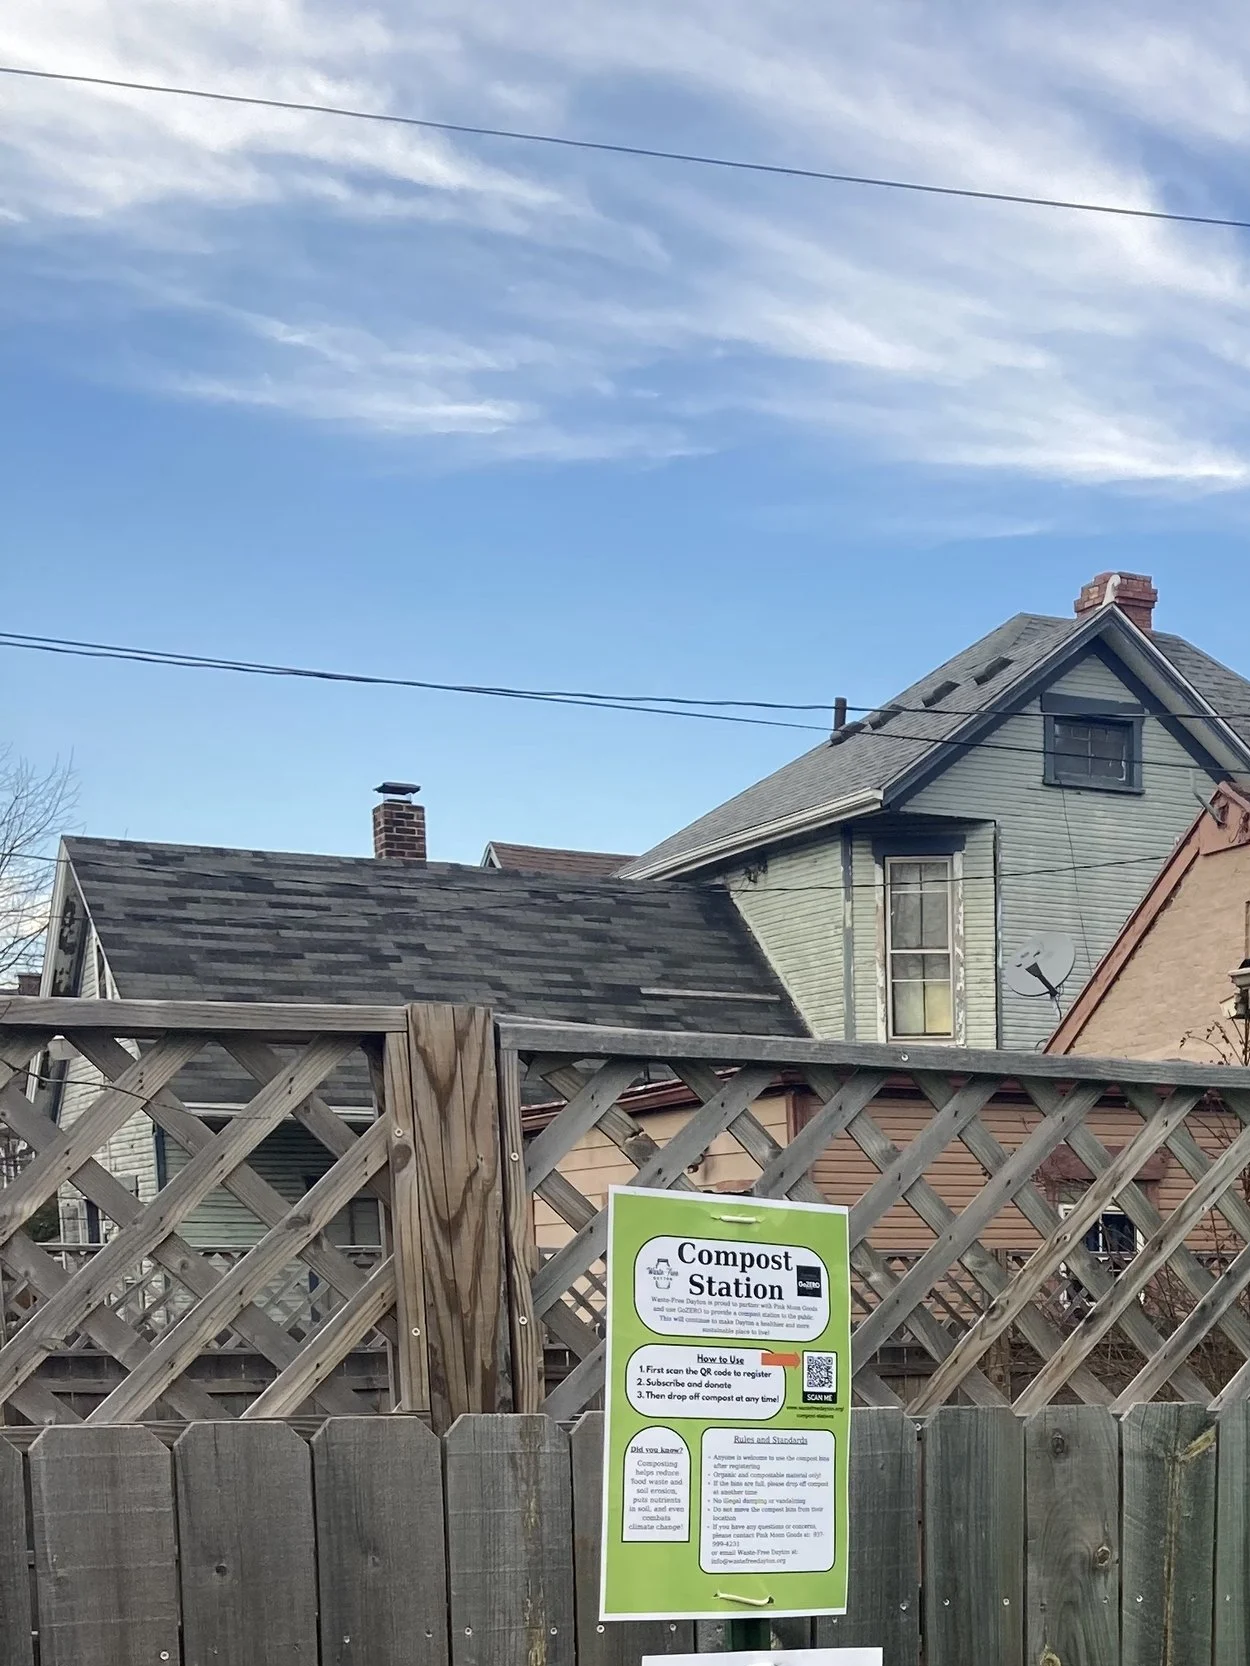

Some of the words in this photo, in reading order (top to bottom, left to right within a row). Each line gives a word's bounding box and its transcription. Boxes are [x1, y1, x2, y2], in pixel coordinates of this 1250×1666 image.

[677, 1241, 795, 1273] Compost
[688, 1274, 784, 1301] Station
[697, 1354, 717, 1364] How
[719, 1355, 728, 1364] to
[729, 1355, 744, 1365] Use
[639, 1365, 645, 1373] 1.
[646, 1366, 664, 1374] First
[685, 1367, 699, 1375] the
[700, 1368, 712, 1377] QR
[743, 1370, 772, 1379] register
[637, 1378, 645, 1386] 2.
[646, 1378, 685, 1387] Subscribe
[704, 1381, 732, 1389] donate
[637, 1391, 645, 1399] 3.
[645, 1391, 666, 1399] Then
[667, 1392, 687, 1402] drop
[689, 1392, 701, 1400] off
[701, 1395, 734, 1403] compost
[761, 1395, 779, 1403] time!
[807, 1392, 823, 1401] SCAN
[824, 1392, 834, 1402] ME
[734, 1435, 754, 1444] Rules
[757, 1436, 770, 1444] and
[772, 1436, 808, 1445] Standards
[660, 1446, 683, 1454] know?
[636, 1460, 678, 1469] Composting
[635, 1469, 655, 1477] helps
[633, 1497, 649, 1505] puts
